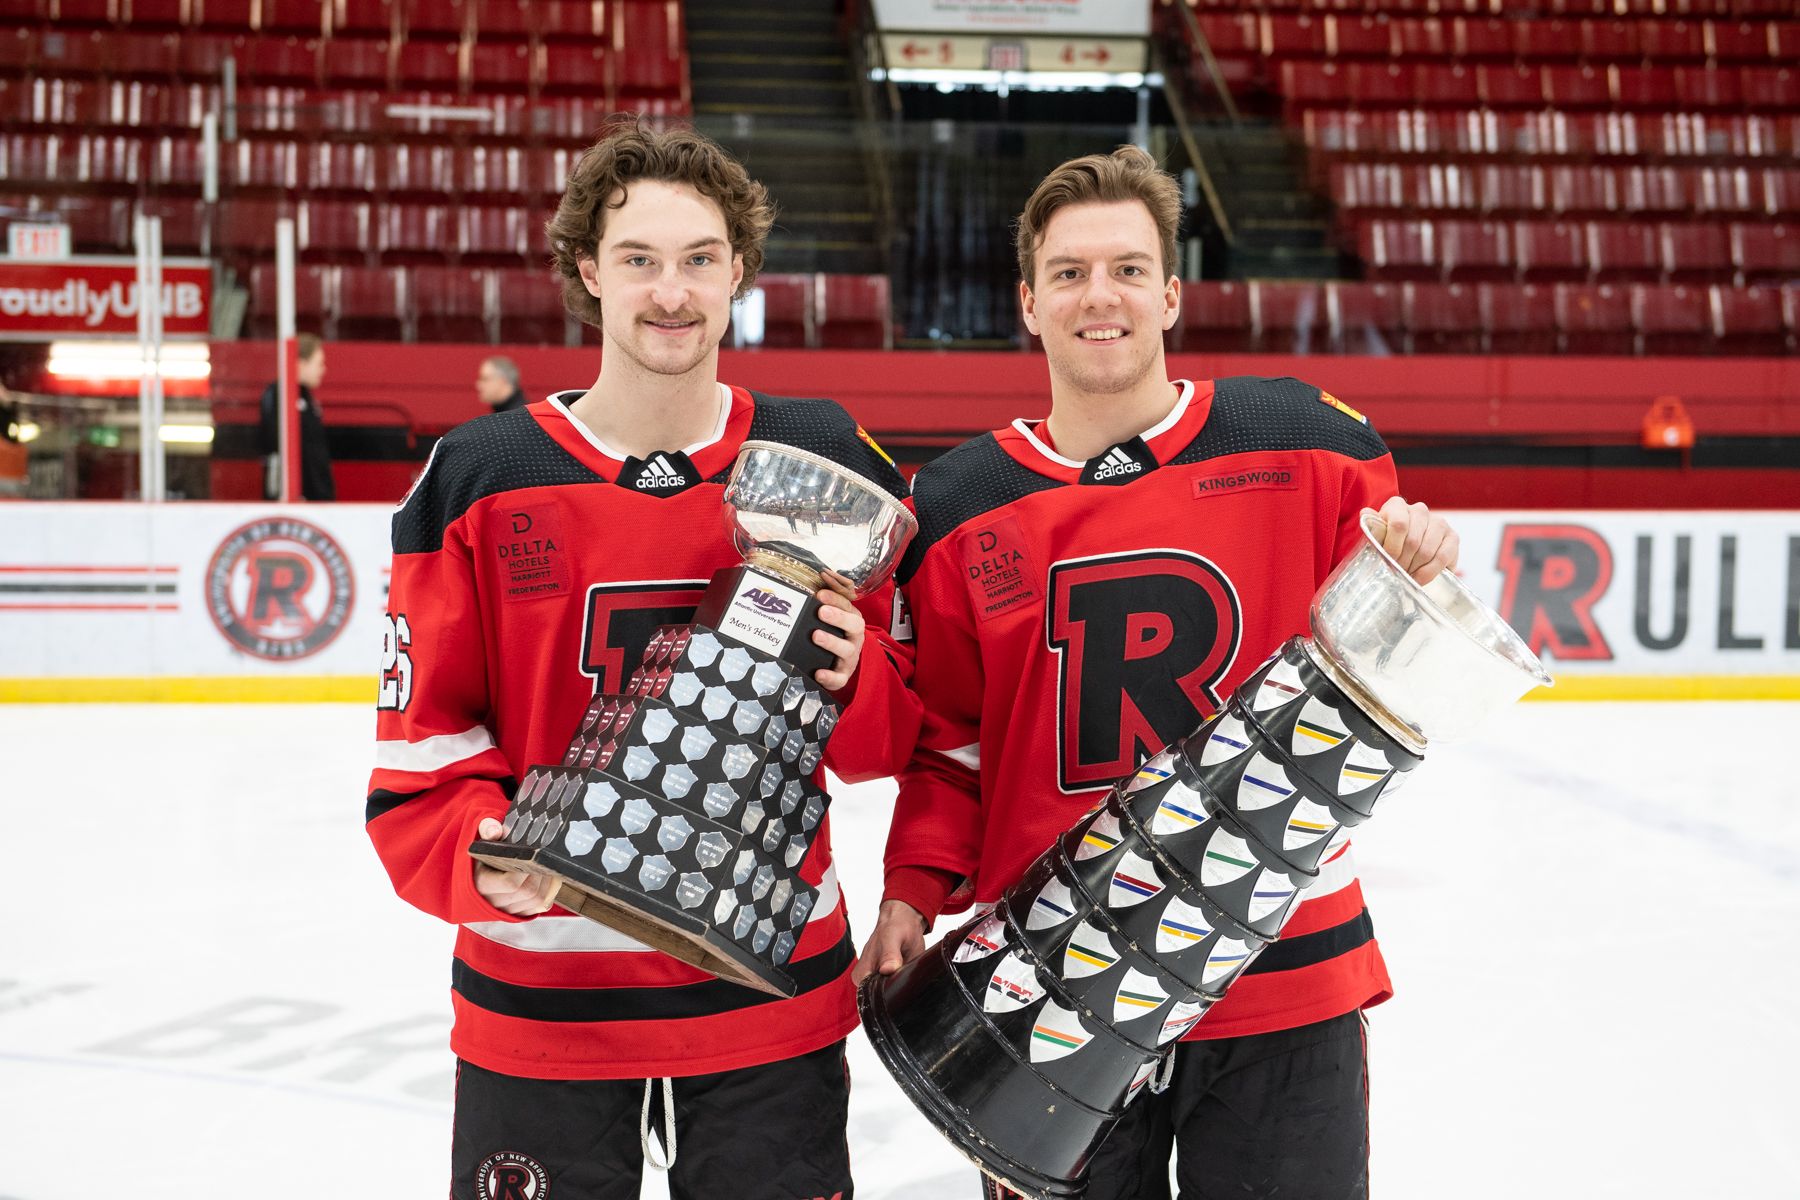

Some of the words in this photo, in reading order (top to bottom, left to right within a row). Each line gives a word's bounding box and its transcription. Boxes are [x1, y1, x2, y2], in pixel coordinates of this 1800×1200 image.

[636, 475, 686, 488] adidas
[1094, 462, 1142, 480] adidas
[1198, 471, 1291, 491] KINGSWOOD
[498, 538, 557, 558] DELTA
[508, 556, 550, 569] HOTELS
[968, 549, 1023, 579] DELTA
[511, 570, 552, 582] MARRIOTT
[981, 566, 1020, 587] HOTELS
[247, 551, 317, 626] R
[508, 582, 560, 595] FREDERICTON
[986, 580, 1024, 599] MARRIOTT
[741, 587, 792, 616] AUS
[985, 591, 1033, 613] FREDERICTON
[734, 601, 753, 612] Atlantic
[752, 608, 777, 623] University
[777, 618, 791, 629] Sport
[729, 617, 752, 631] Men's
[753, 626, 780, 647] Hockey
[1046, 548, 1243, 795] R
[495, 1153, 505, 1161] OF
[509, 1154, 527, 1163] NEW
[528, 1160, 547, 1200] BRUNSWIC
